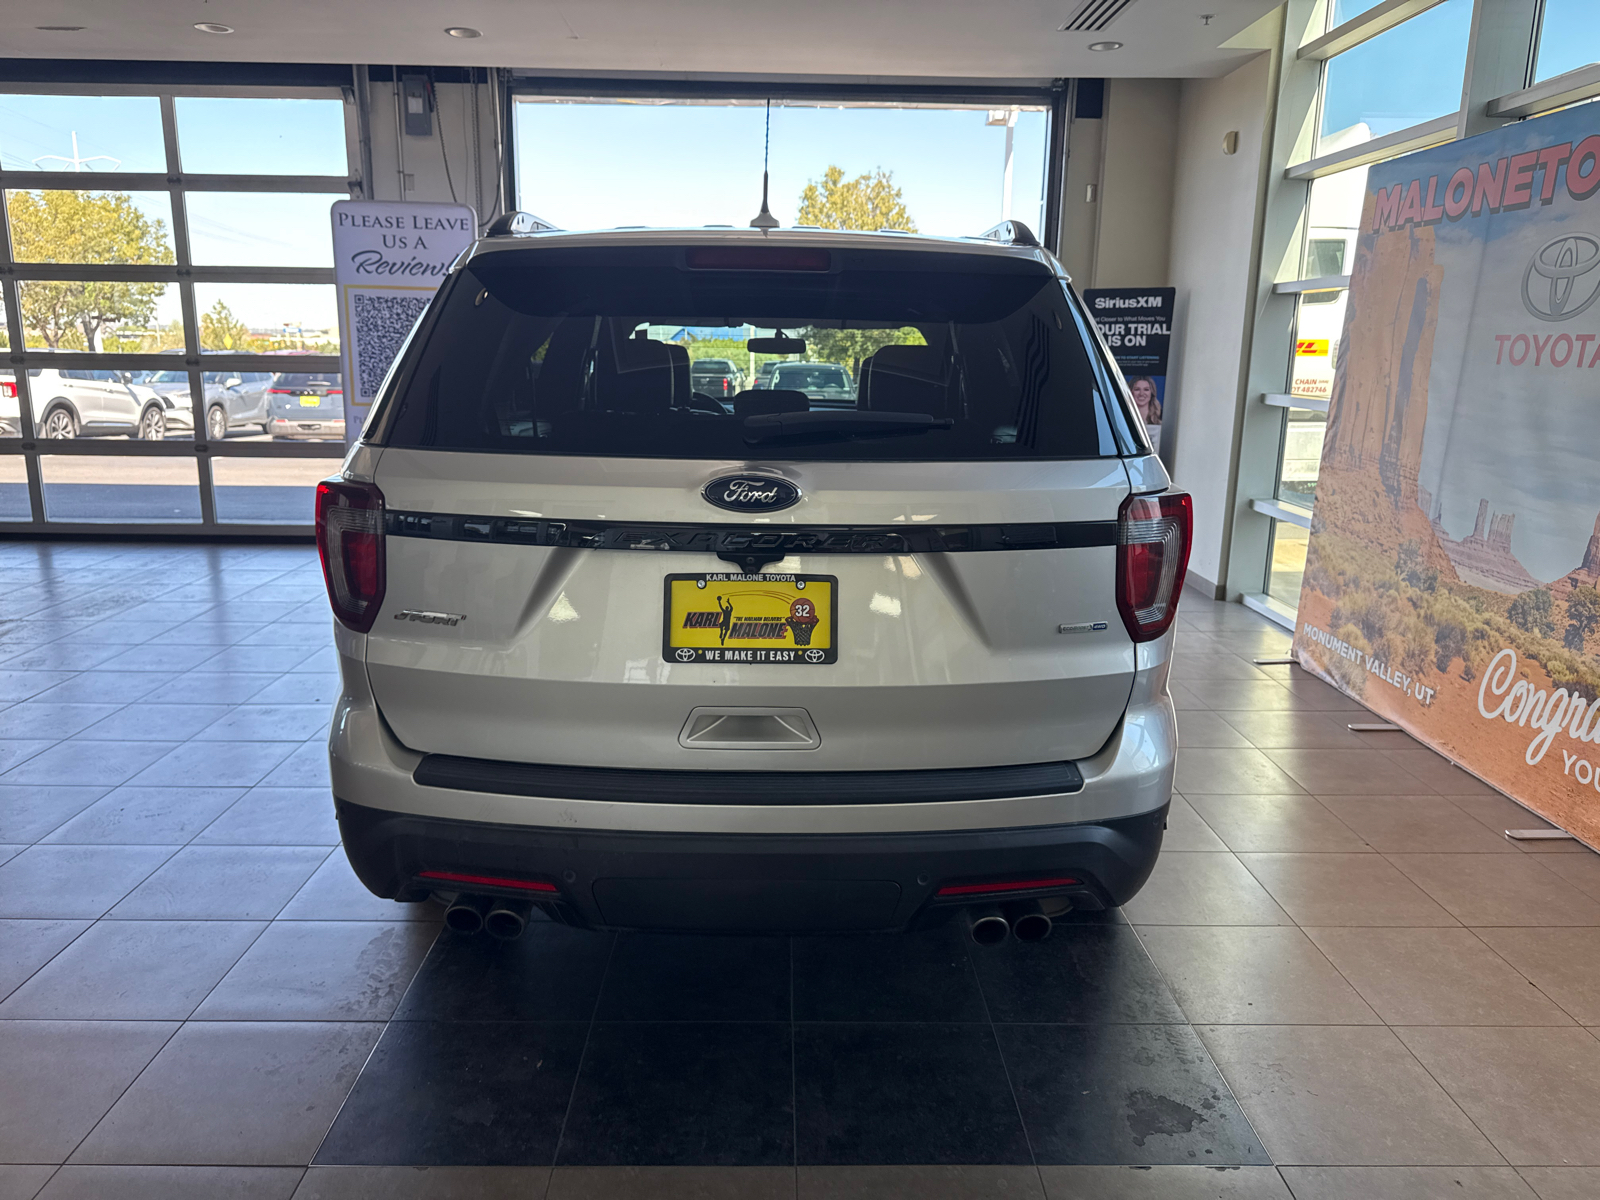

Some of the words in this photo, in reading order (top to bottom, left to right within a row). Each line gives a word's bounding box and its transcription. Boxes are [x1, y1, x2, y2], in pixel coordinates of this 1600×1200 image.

[338, 212, 406, 230] PLEASE
[412, 215, 470, 231] LEAVE
[382, 234, 408, 250] US
[413, 236, 428, 250] A
[1094, 296, 1163, 309] SiriusXM
[1097, 323, 1125, 335] OUR
[1128, 323, 1171, 335] TRIAL
[1107, 335, 1121, 347] IS
[1124, 335, 1146, 347] ON
[723, 480, 778, 503] Ford
[730, 574, 764, 582] MALONE
[765, 574, 796, 582] TOYOTA
[795, 604, 810, 617] 32
[683, 612, 722, 629] KARL
[728, 621, 788, 639] MALONE
[705, 650, 721, 661] WE
[724, 650, 753, 661] MAKE
[757, 651, 766, 661] IT
[769, 651, 795, 661] EASY
[1303, 622, 1363, 665] MONUMENT
[1365, 655, 1412, 697] VALLEY,
[1414, 682, 1434, 705] UT
